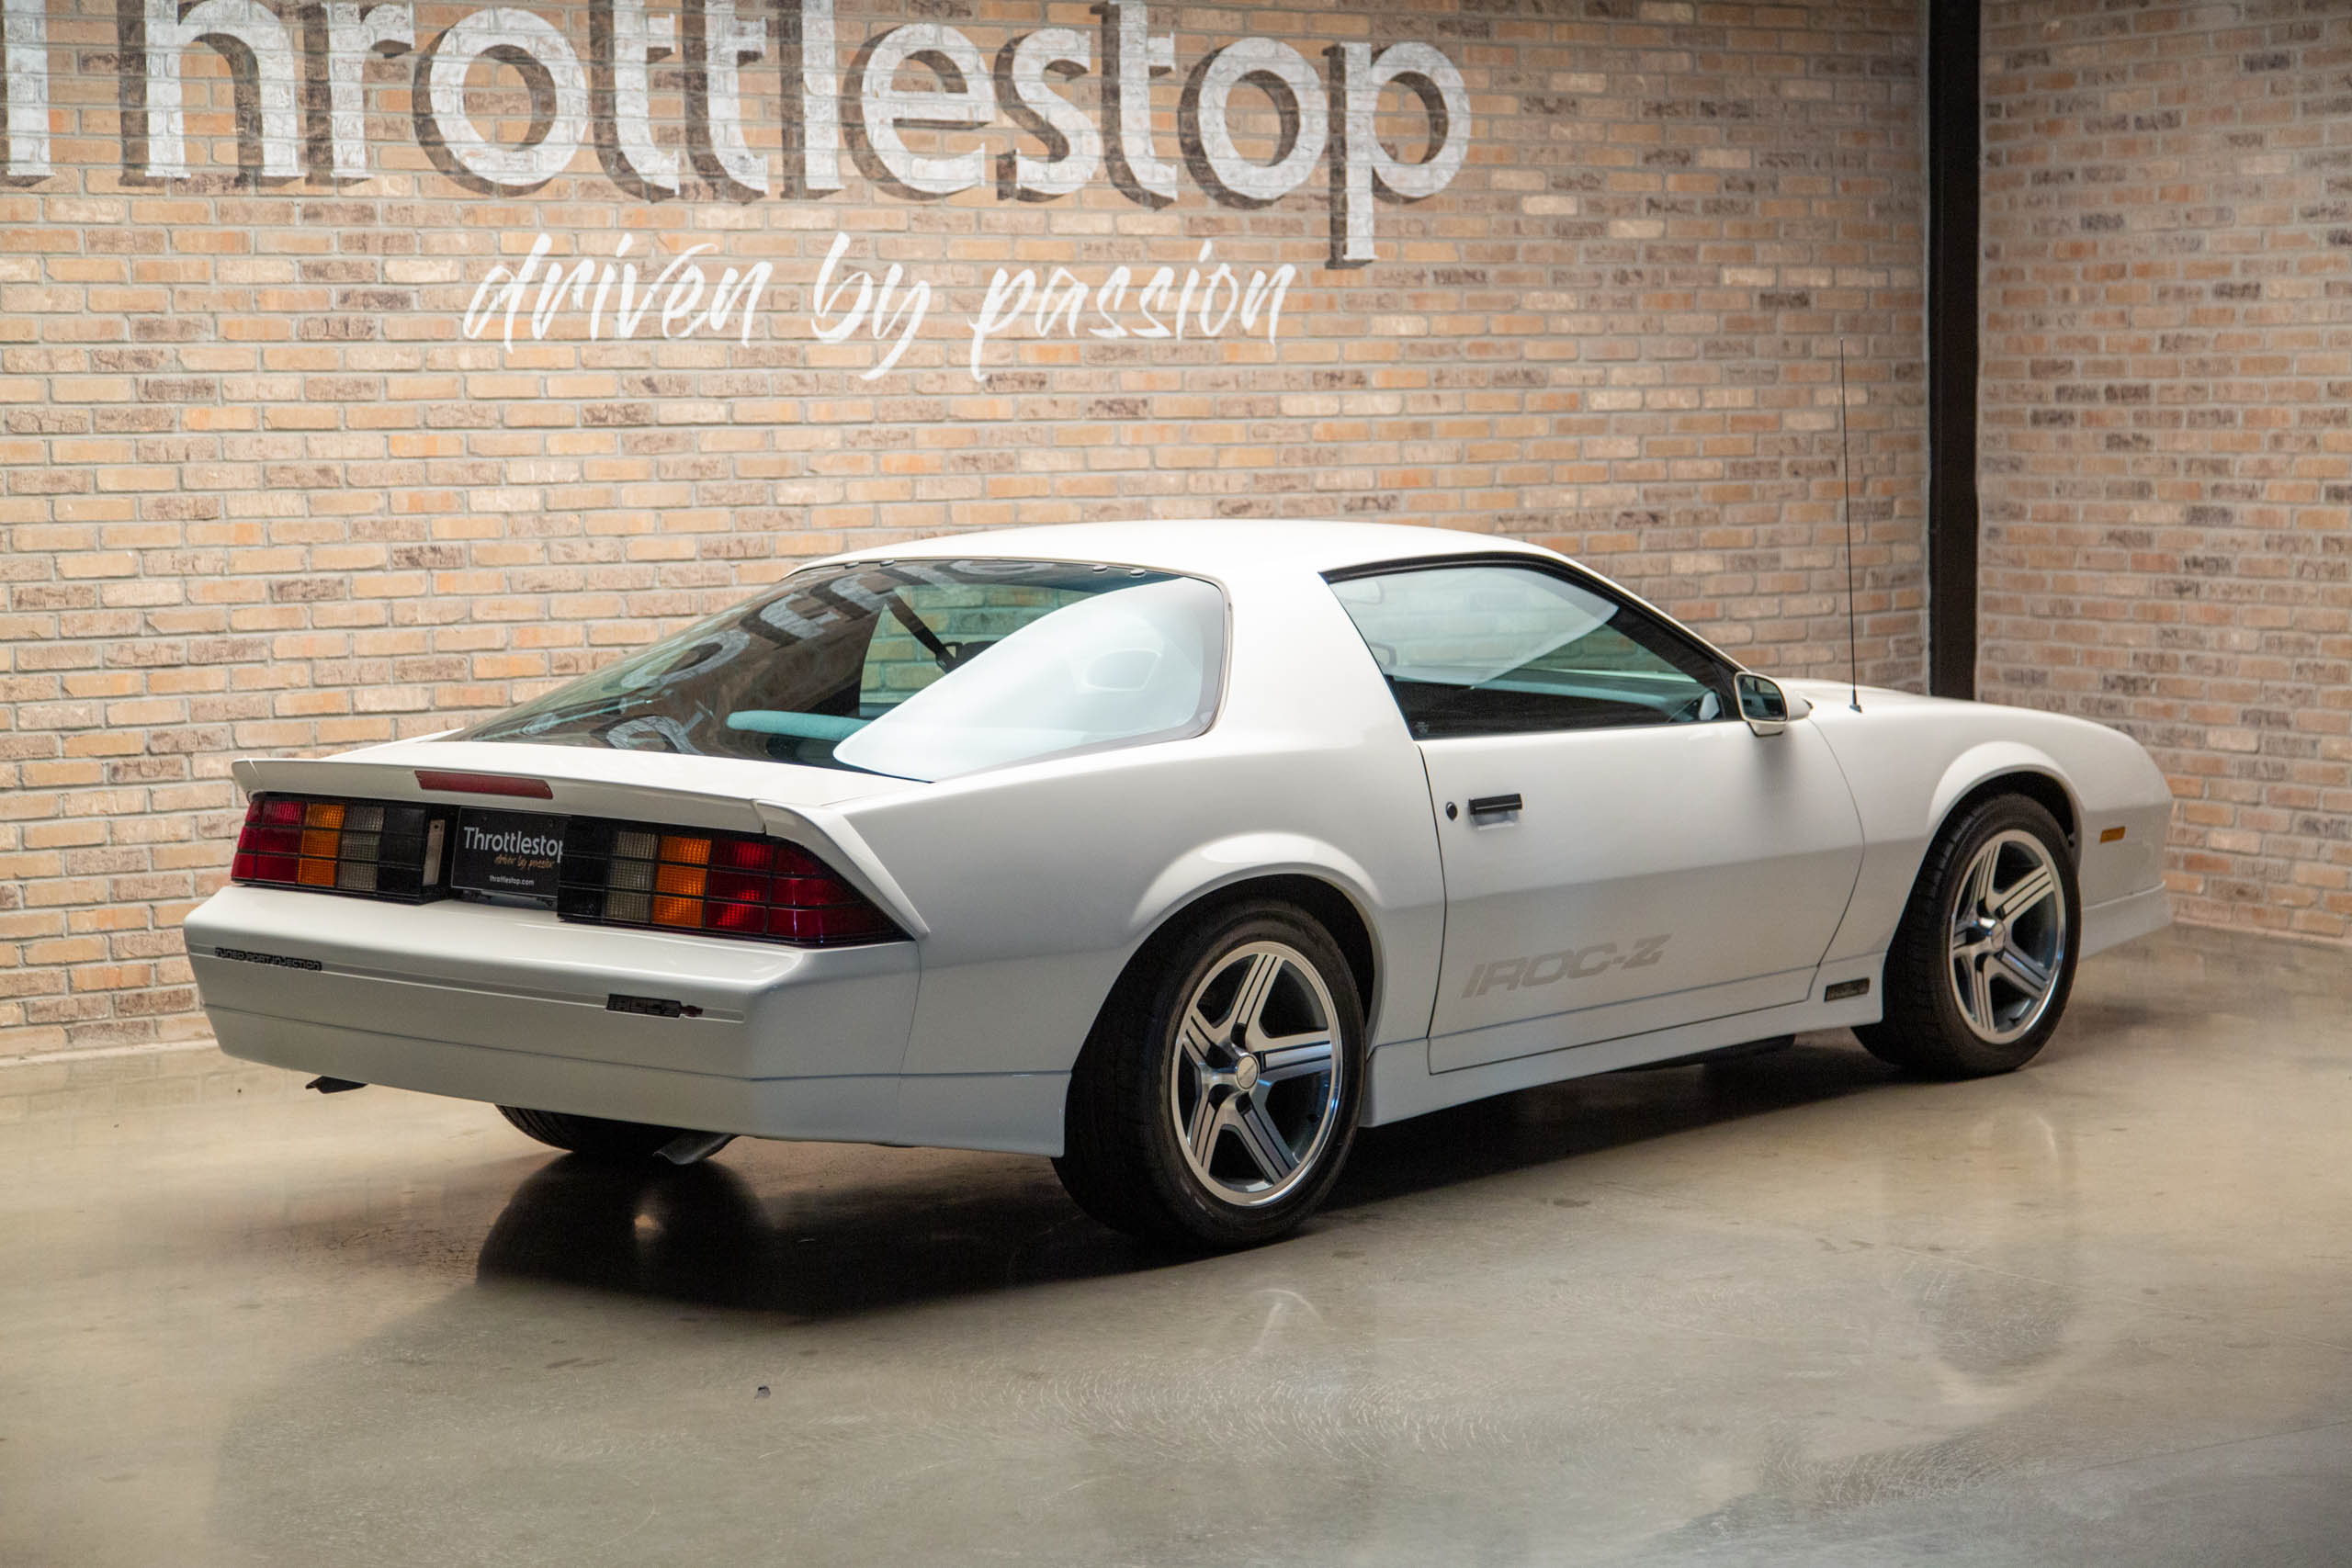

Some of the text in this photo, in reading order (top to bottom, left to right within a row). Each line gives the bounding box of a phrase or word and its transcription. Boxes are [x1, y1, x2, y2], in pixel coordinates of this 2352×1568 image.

[462, 231, 1297, 383] driven by passion
[489, 874, 535, 886] throttlestop.com
[1460, 933, 1674, 999] IROC-Z
